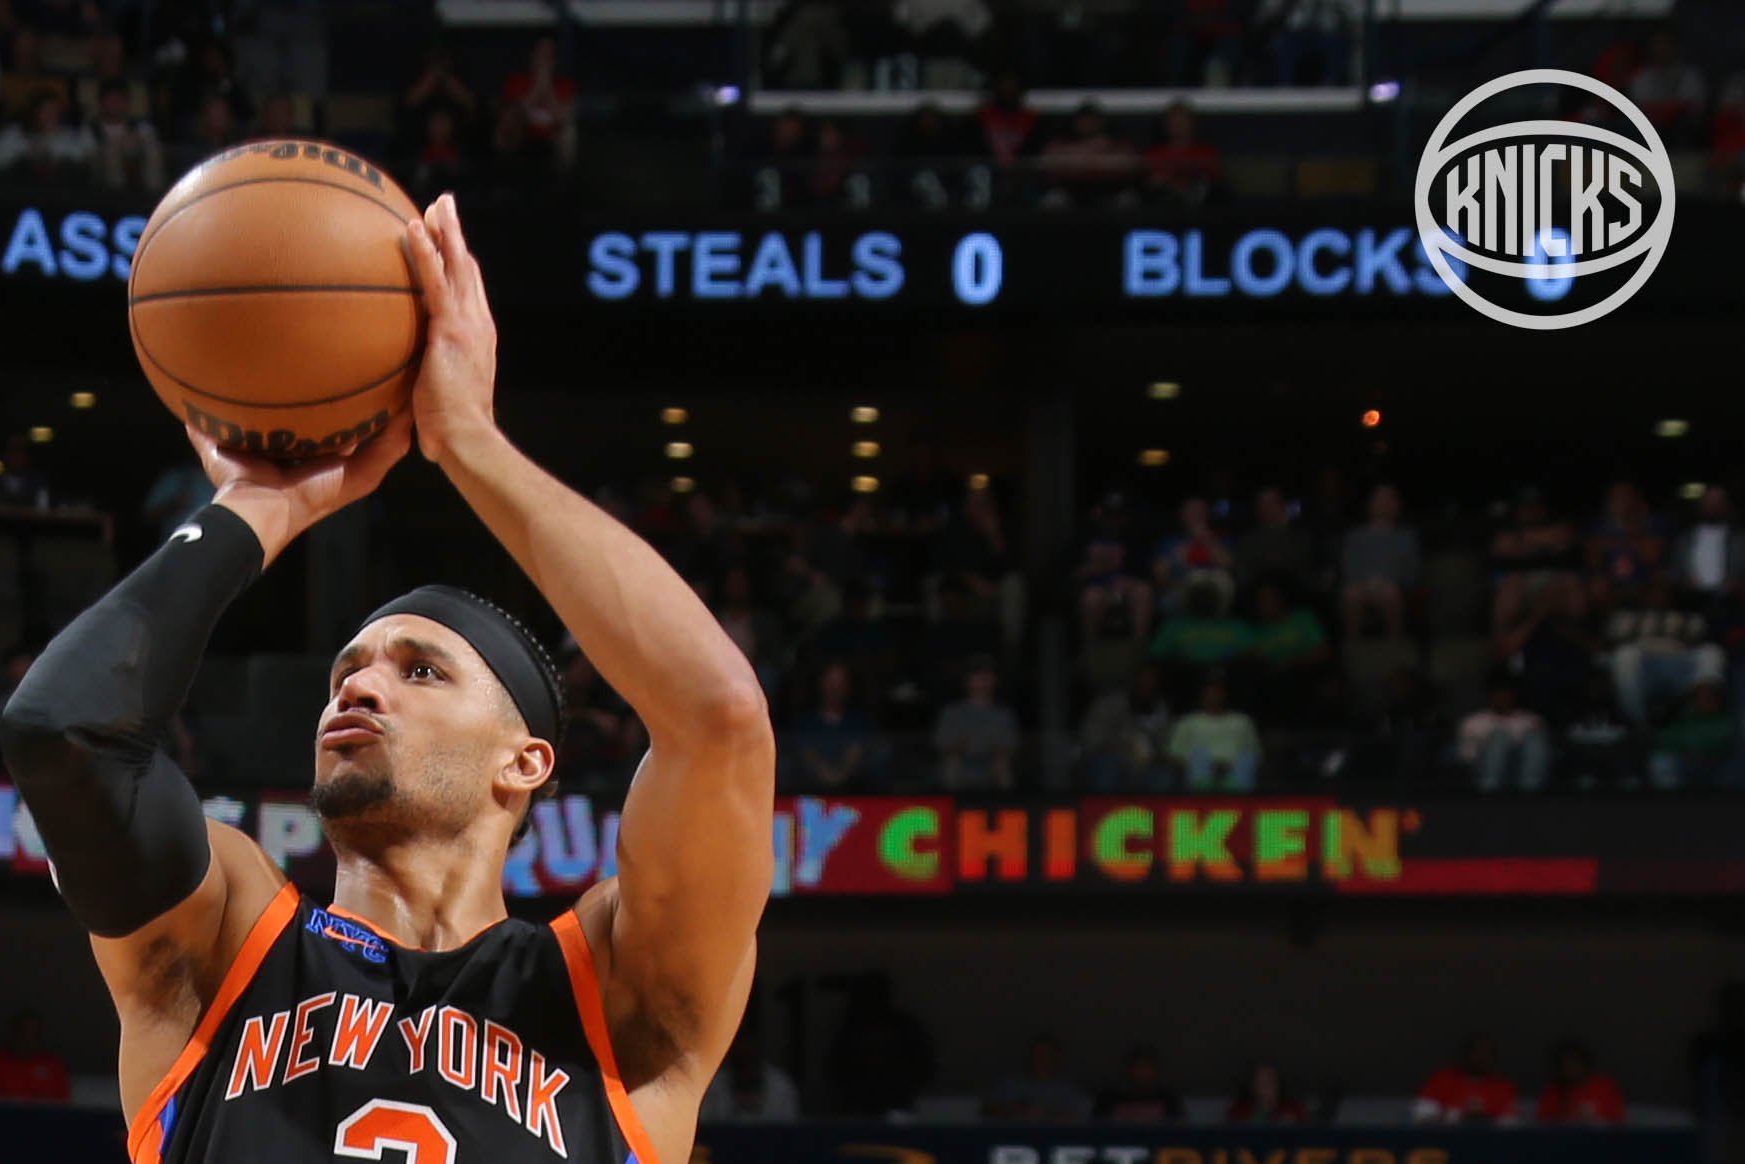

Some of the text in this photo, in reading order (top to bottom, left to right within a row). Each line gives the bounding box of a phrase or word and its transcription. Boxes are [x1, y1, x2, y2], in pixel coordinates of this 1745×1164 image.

[587, 230, 903, 302] STEALS
[952, 232, 1003, 306] 0
[1123, 228, 1468, 298] BLOCKS
[878, 805, 1404, 882] CHICKEN
[305, 907, 390, 964] NYC
[225, 991, 571, 1158] NEW YORK
